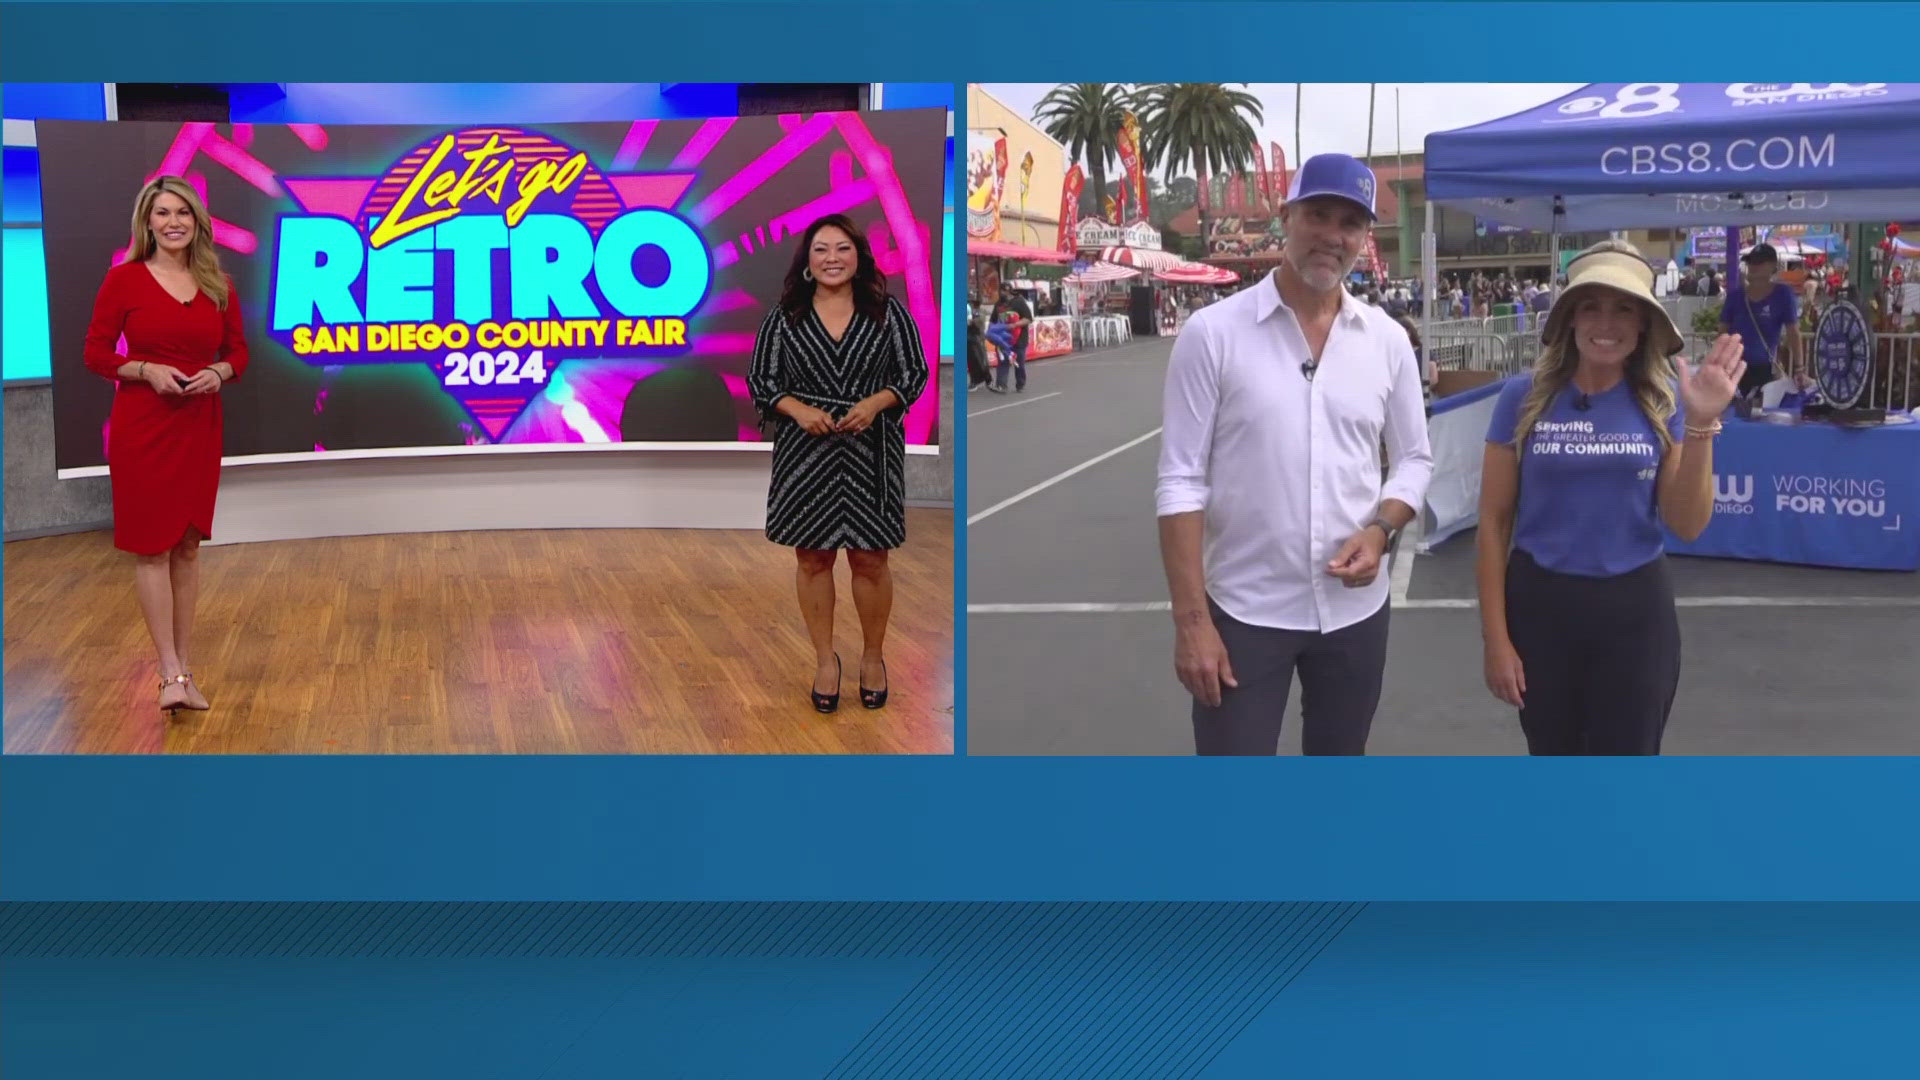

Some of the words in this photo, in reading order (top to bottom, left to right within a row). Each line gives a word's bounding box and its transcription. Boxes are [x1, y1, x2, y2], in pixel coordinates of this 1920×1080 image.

[1601, 134, 1836, 176] CBS8.COM
[371, 134, 516, 248] Let's
[505, 152, 588, 226] go
[1084, 230, 1117, 241] CREAM
[274, 211, 709, 331] RETRO
[294, 326, 359, 354] SAN
[367, 324, 470, 351] DIEGO
[476, 320, 609, 350] COUNTY
[616, 319, 685, 346] FAIR
[444, 351, 546, 386] 2024
[1535, 421, 1594, 433] SERVING
[1553, 433, 1596, 442] GREATER
[1599, 433, 1629, 442] GOOD
[1533, 443, 1561, 454] OUR
[1564, 443, 1654, 457] COMMUNITY
[1712, 474, 1754, 503] W
[1772, 475, 1886, 499] WORKING
[1714, 503, 1754, 515] DIEGO
[1776, 494, 1826, 514] FOR
[1831, 497, 1886, 518] YOU
